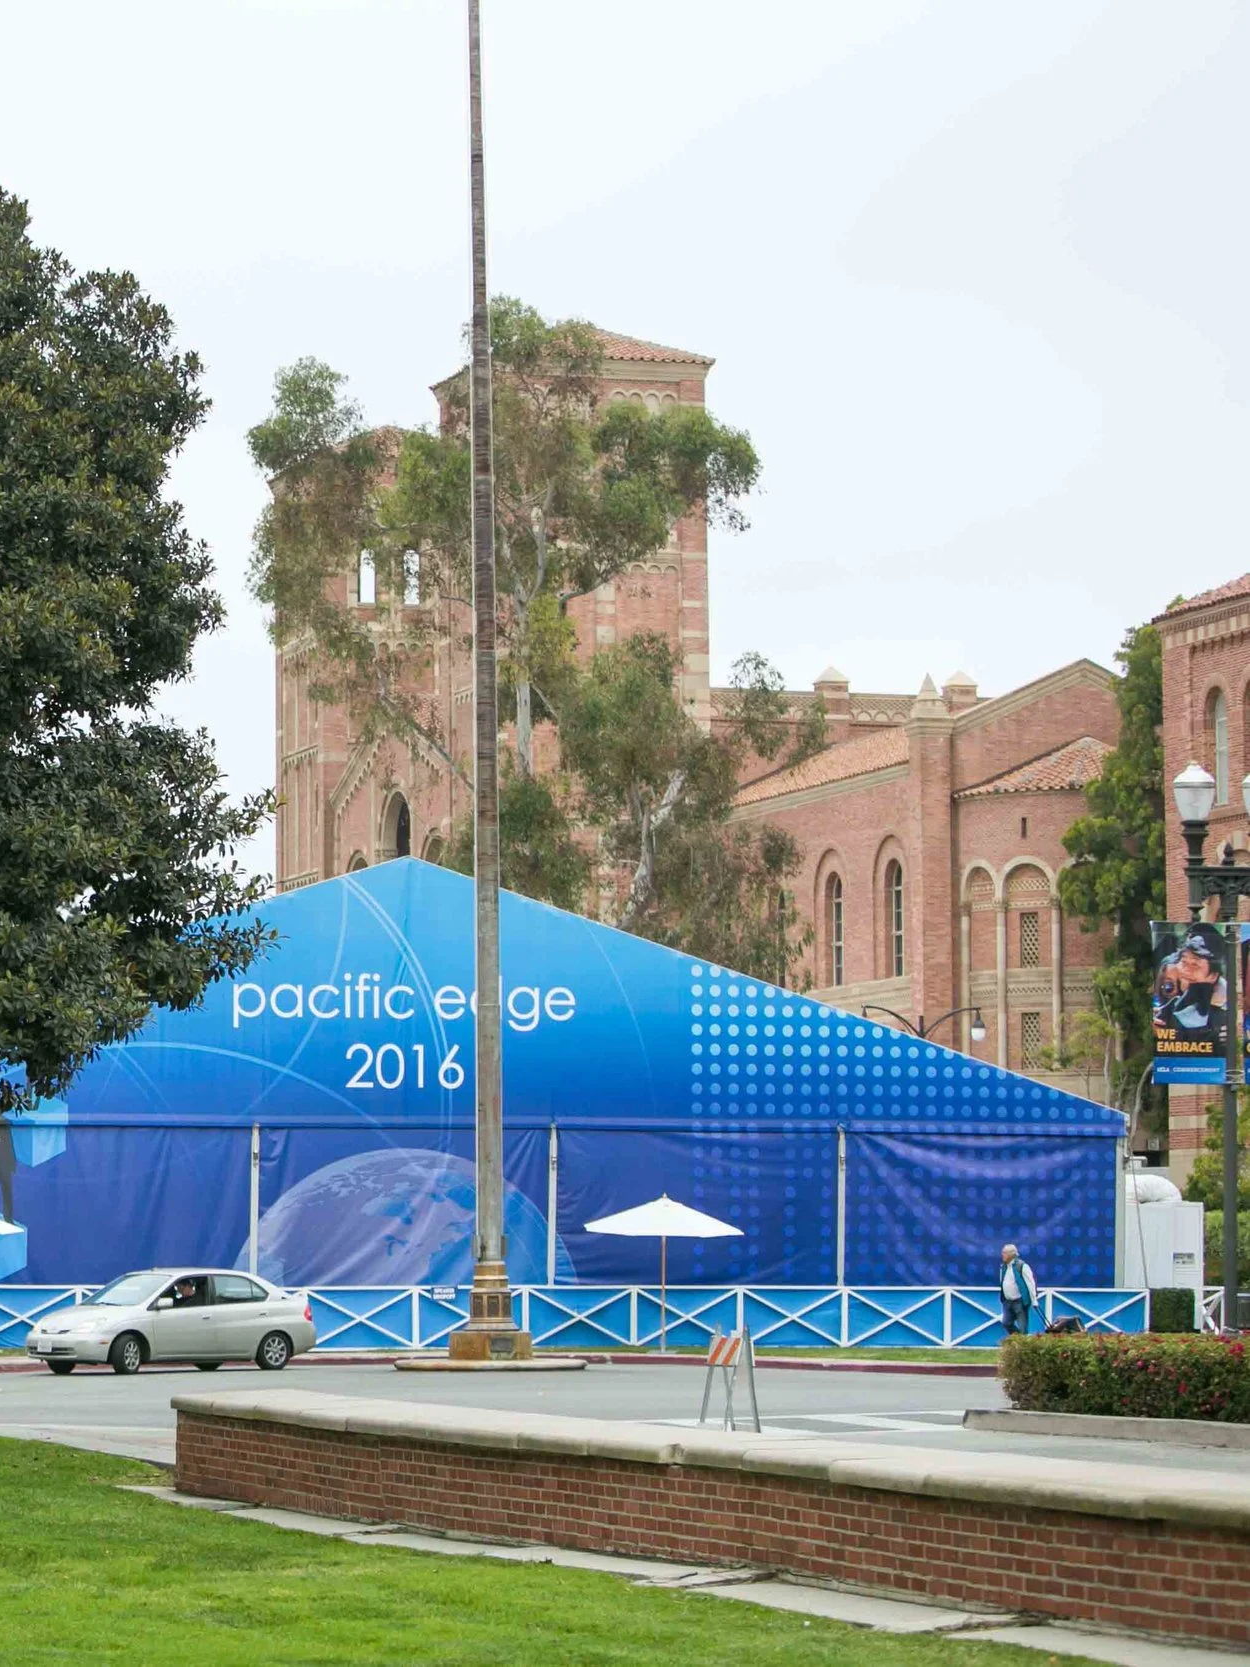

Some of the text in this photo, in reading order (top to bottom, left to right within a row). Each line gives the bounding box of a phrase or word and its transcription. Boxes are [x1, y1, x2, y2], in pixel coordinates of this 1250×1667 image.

[232, 973, 415, 1028] pacific
[1156, 1028, 1176, 1040] WE
[1156, 1041, 1213, 1053] EMBRACE
[345, 1044, 465, 1089] 2016
